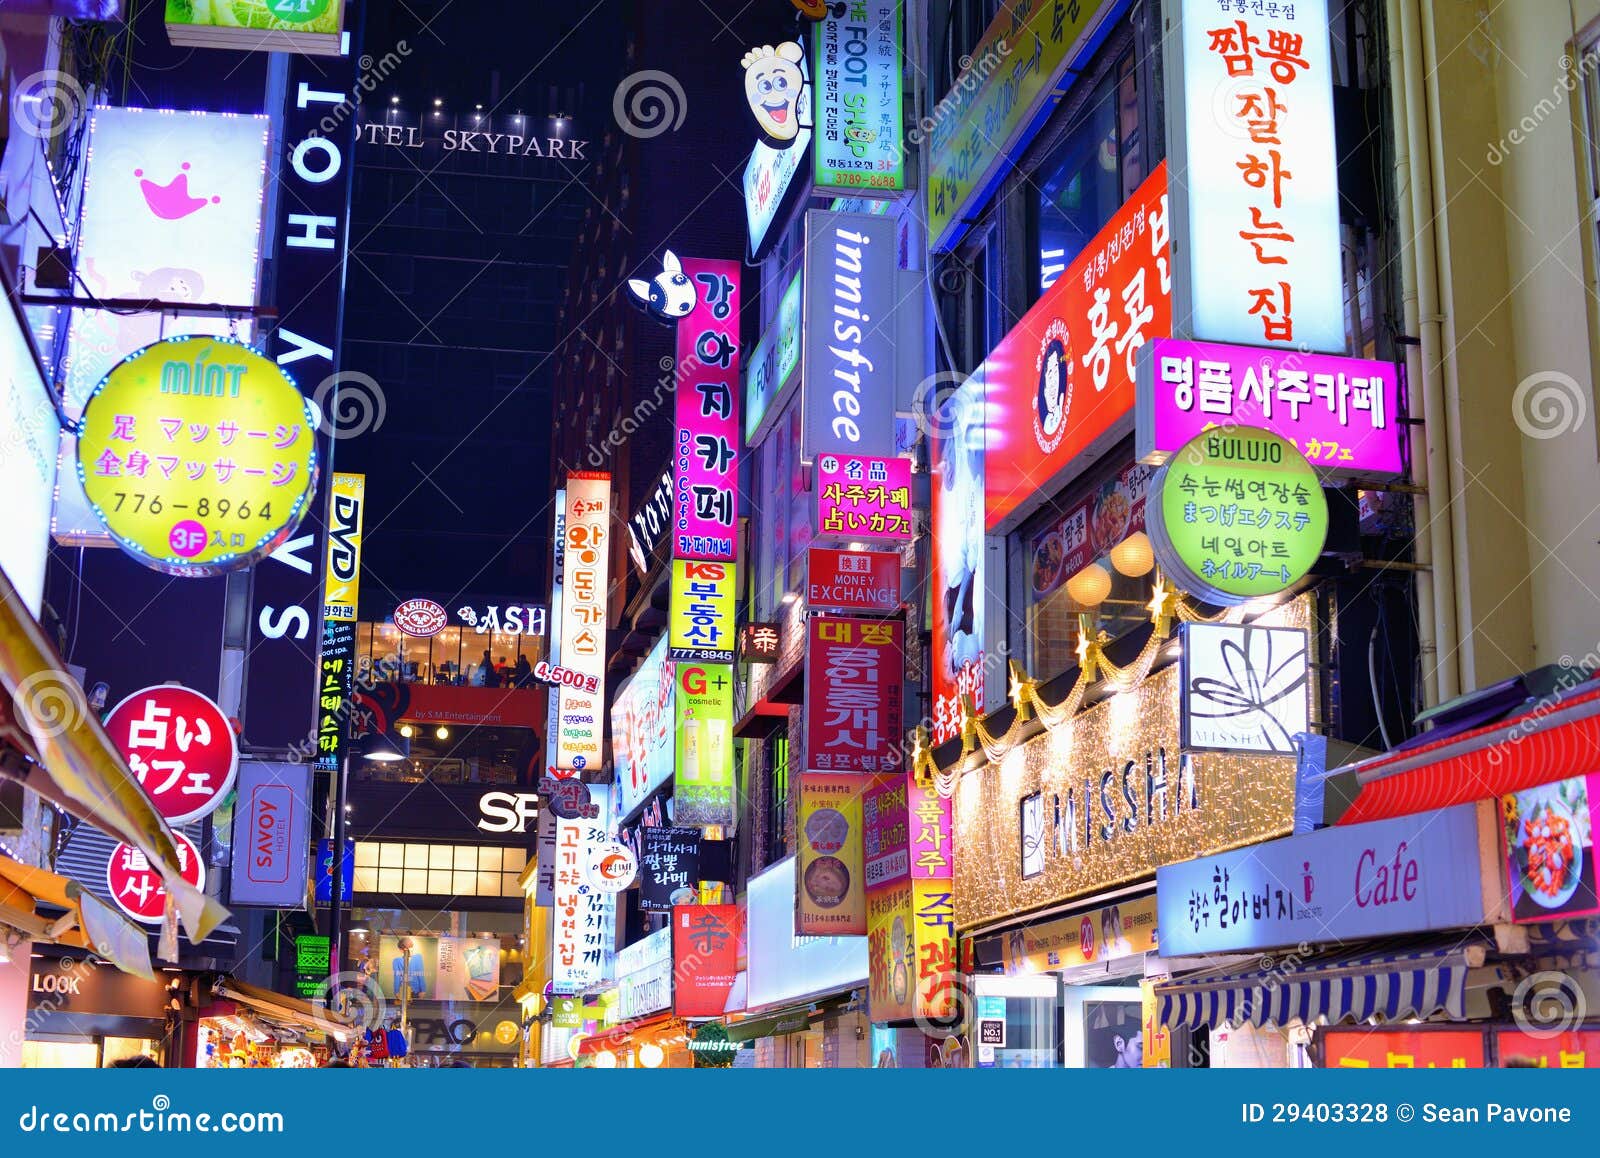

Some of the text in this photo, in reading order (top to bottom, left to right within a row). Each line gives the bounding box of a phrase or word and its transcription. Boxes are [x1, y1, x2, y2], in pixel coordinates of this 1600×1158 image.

[844, 26, 868, 88] FOOT
[1206, 19, 1310, 84] 짬뽕
[826, 107, 838, 141] 전문점
[286, 31, 350, 249] HOT
[355, 124, 589, 161] TEL SKYPARK
[1247, 281, 1293, 342] 집
[832, 229, 873, 443] innisfree
[692, 272, 737, 526] 강아지카페
[1161, 356, 1386, 429] 명품사주카페
[111, 415, 300, 449] 足 マッサージ
[1208, 437, 1282, 464] BULUJO
[95, 449, 297, 485] 全身マッサージ
[678, 428, 691, 530] Dog Cafe
[823, 460, 887, 481] 4F 名品
[258, 328, 336, 641] SAY
[822, 484, 910, 509] 사주카페
[113, 493, 272, 521] 776-8964
[573, 499, 603, 517] 수제
[823, 508, 911, 534] 占いカフェ
[1184, 502, 1310, 532] まつげエクステ
[172, 528, 245, 548] 3F 入口
[328, 495, 359, 582] DVD
[680, 537, 732, 556] 카페개네
[1201, 535, 1290, 559] 네일아트
[685, 564, 726, 580] KS
[834, 575, 875, 586] MONEY
[1201, 559, 1292, 583] ネイルアート
[568, 524, 603, 653] 왕돈가스
[810, 585, 898, 606] EXCHANGE
[683, 583, 723, 647] 부동산
[818, 623, 893, 645] 대명
[672, 649, 732, 660] 777-8945
[537, 662, 599, 692] 4,500원
[682, 668, 728, 694] G+
[129, 700, 211, 752] 占い
[573, 757, 585, 767] 3F
[1053, 747, 1199, 858] MISSHA
[257, 800, 278, 867] SAVOY
[277, 818, 287, 851] HOTEL
[647, 842, 697, 854] 나가사키
[643, 853, 678, 872] 짬뽕
[1354, 842, 1418, 908] Cafe
[1189, 865, 1293, 933] 향수 할아버지
[582, 893, 604, 967] 김치찌개
[916, 893, 954, 938] 죽
[1082, 924, 1093, 952] 20
[33, 974, 80, 995] LOOK
[688, 1039, 744, 1051] innisfree
